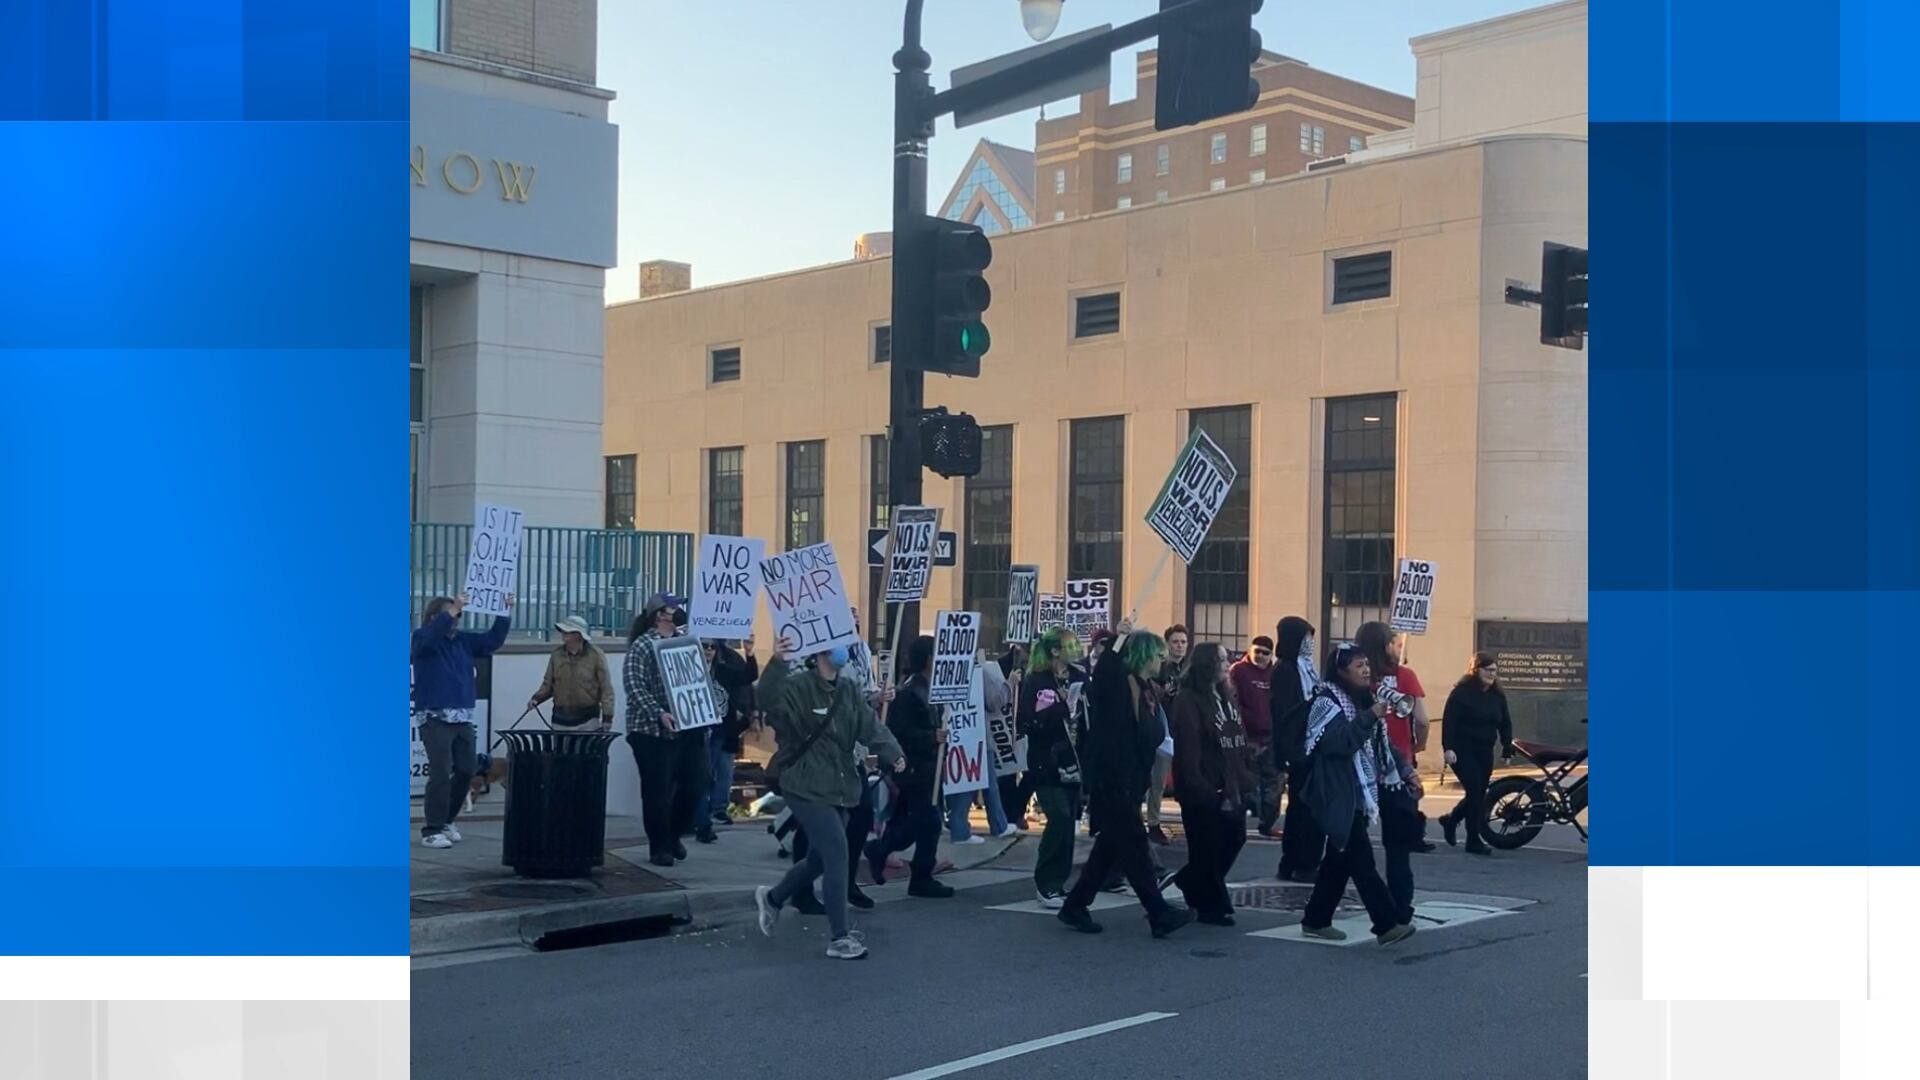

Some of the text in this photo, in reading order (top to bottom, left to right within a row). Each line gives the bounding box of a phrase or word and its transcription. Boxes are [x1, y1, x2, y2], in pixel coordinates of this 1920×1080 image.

[1178, 449, 1208, 491] NO
[1170, 480, 1211, 533] WAR
[483, 507, 522, 535] IS IT
[894, 523, 914, 554] NO
[713, 543, 750, 570] NO
[759, 544, 837, 584] NO MORE
[1408, 562, 1429, 573] NO
[702, 571, 752, 597] WAR
[764, 569, 837, 611] WAR
[1067, 581, 1109, 598] US
[1399, 573, 1434, 596] BLOOD
[715, 600, 733, 613] IN
[1067, 598, 1108, 611] OUT
[1394, 597, 1428, 620] FOR OIL
[780, 615, 853, 653] OIL
[947, 613, 972, 628] NO
[1008, 609, 1031, 640] OFF!
[938, 628, 976, 656] BLOOD
[933, 660, 970, 686] FOR OIL
[677, 687, 714, 727] OFF!
